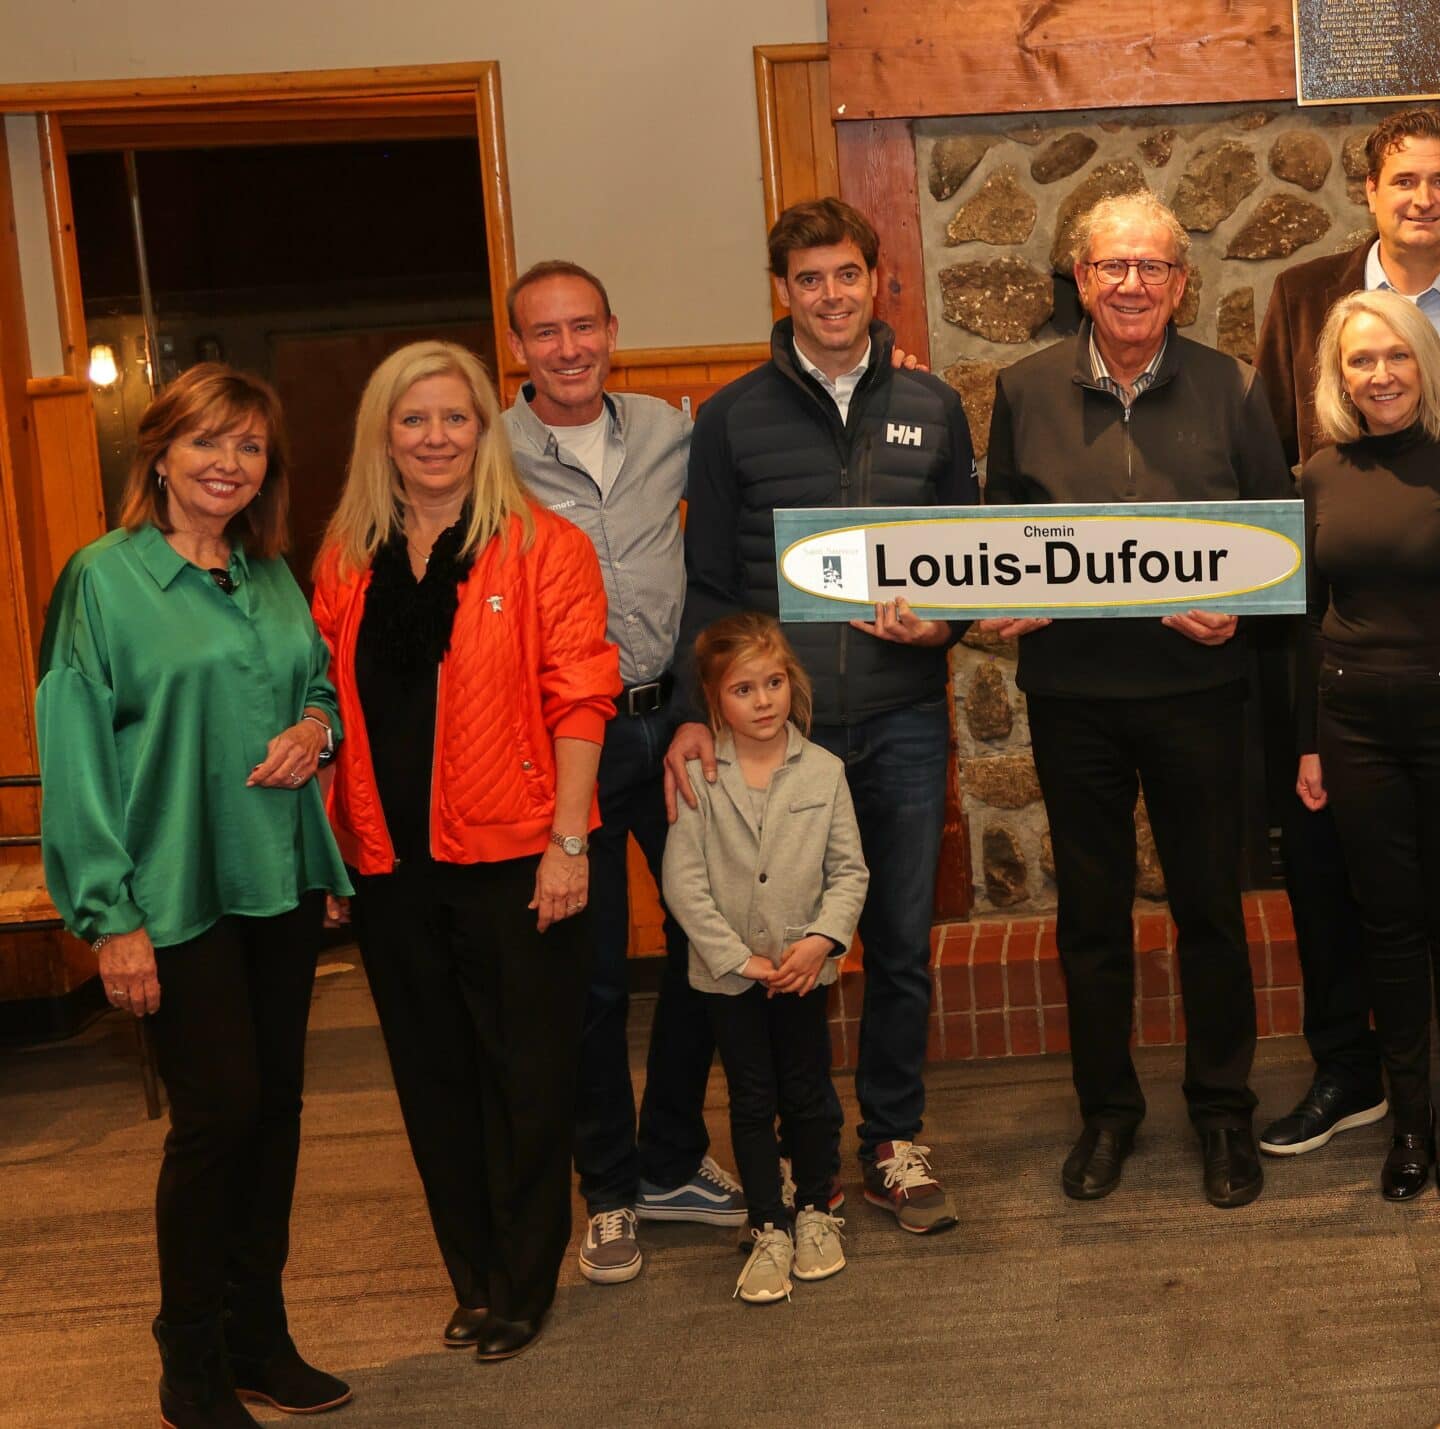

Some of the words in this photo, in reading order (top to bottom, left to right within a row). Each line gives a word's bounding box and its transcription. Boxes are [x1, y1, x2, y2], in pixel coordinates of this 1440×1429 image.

[886, 423, 922, 447] HH
[1023, 525, 1076, 538] Chemin
[876, 539, 1228, 587] Louis-Dufour
